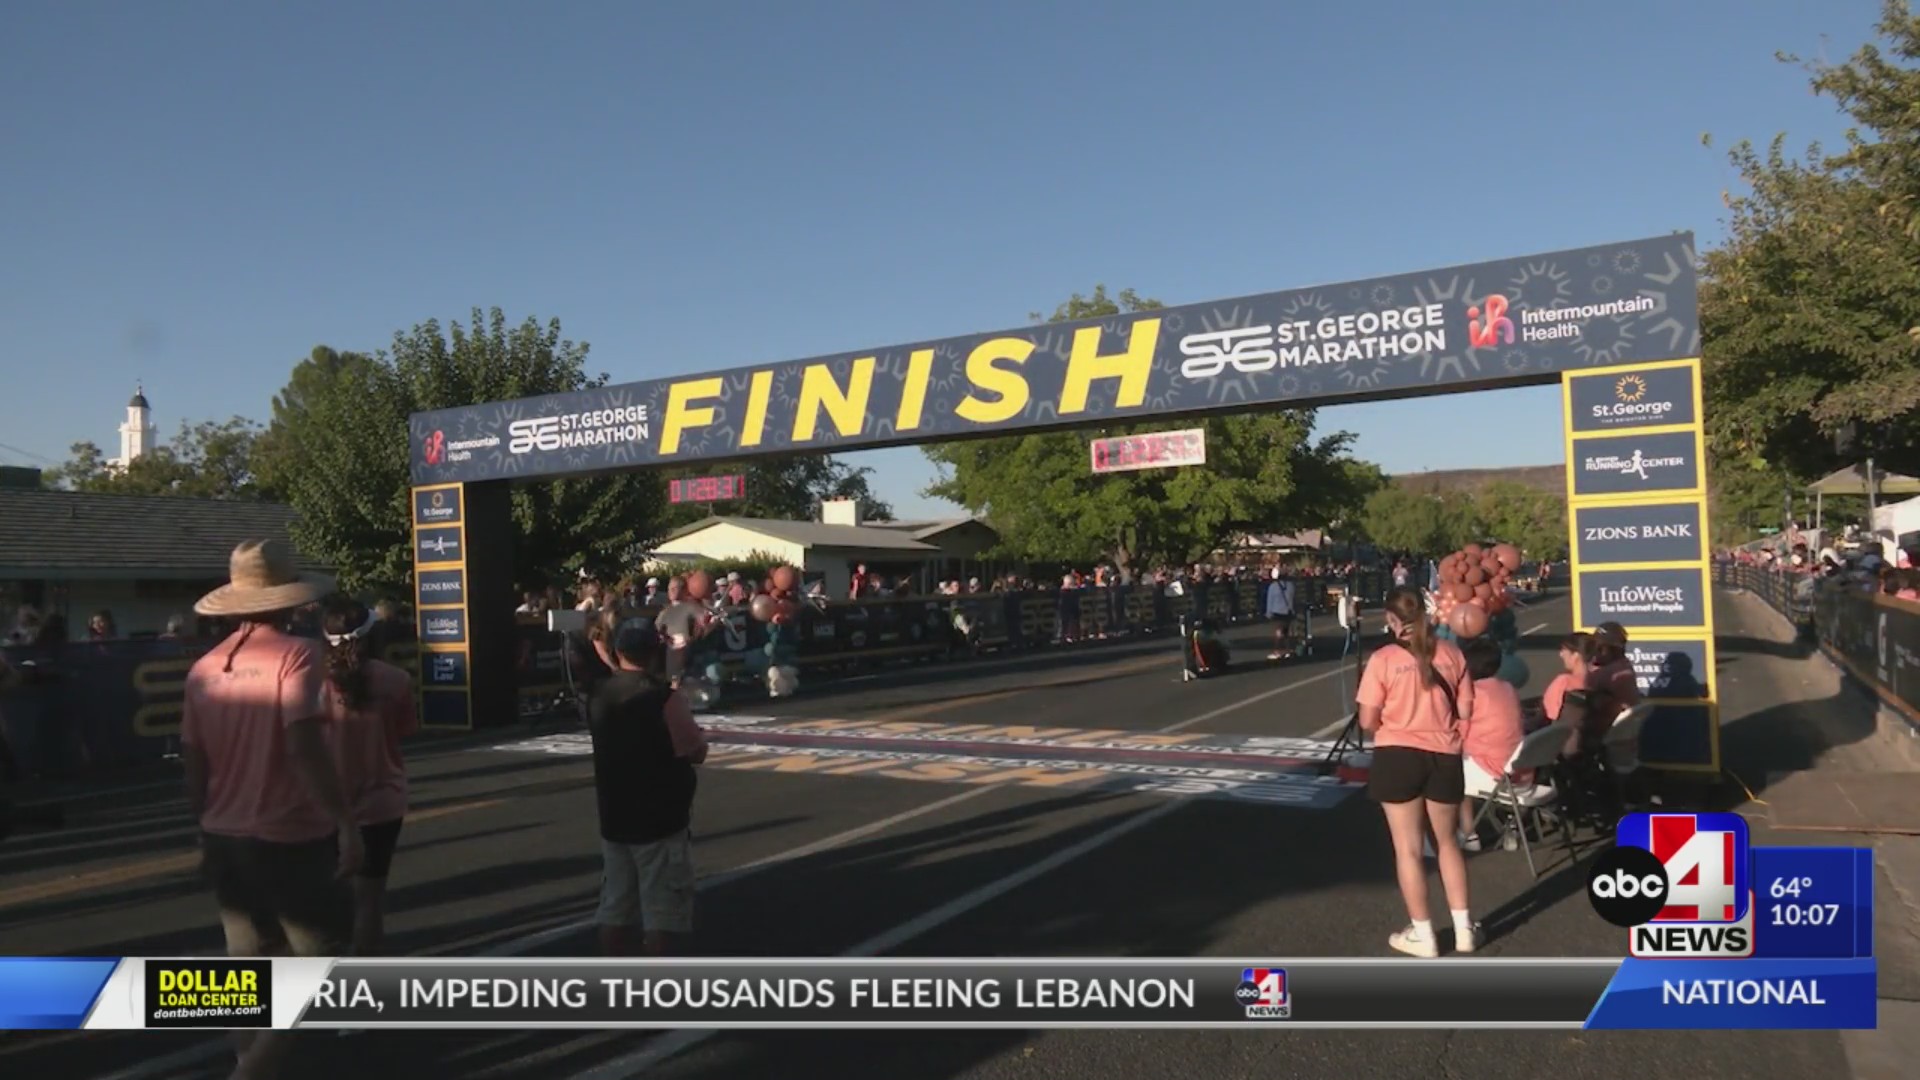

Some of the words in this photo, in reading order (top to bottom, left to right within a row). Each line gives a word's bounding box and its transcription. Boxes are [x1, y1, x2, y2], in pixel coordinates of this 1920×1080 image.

[1521, 296, 1654, 325] Intermountain
[1277, 304, 1444, 343] ST.GEORGE
[1523, 322, 1579, 343] Health
[1280, 329, 1446, 368] MARATHON
[659, 318, 1161, 456] FINISH
[1592, 401, 1672, 417] St.George
[561, 405, 647, 432] ST.GEORGE
[447, 437, 500, 451] Intermountain
[562, 425, 649, 448] MARATHON
[448, 451, 472, 462] Health
[1642, 457, 1684, 467] CENTER
[1585, 526, 1637, 541] ZIONS
[1643, 524, 1692, 538] BANK
[1599, 586, 1683, 602] InfoWest
[1600, 604, 1615, 613] The
[1617, 604, 1651, 612] Internet
[1652, 604, 1684, 613] People
[1624, 648, 1667, 663] njury
[1635, 676, 1671, 688] aw
